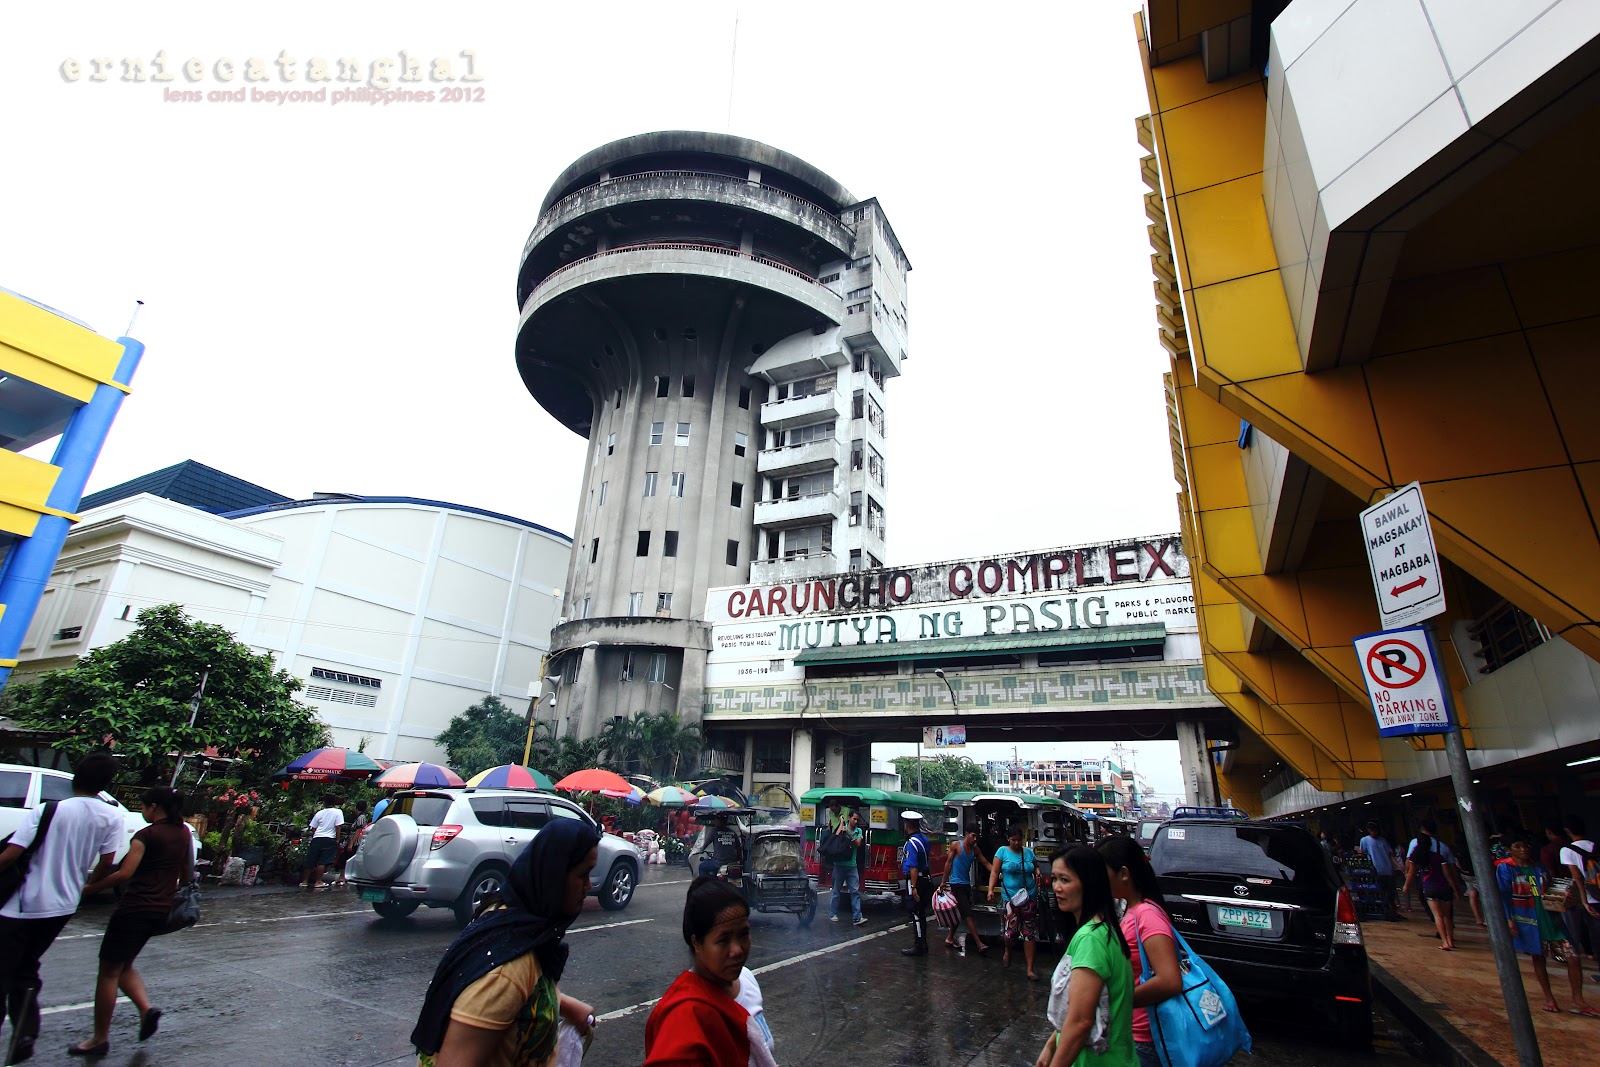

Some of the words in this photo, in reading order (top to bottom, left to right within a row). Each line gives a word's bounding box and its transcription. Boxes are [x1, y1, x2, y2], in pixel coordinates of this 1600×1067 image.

[1374, 502, 1410, 529] BAWAL
[1370, 514, 1424, 550] MAGSAKAY
[1393, 543, 1407, 558] AT
[1380, 553, 1432, 582] MAGBABA
[727, 571, 914, 619] CARUNCHO
[948, 542, 1177, 597] COMPLEX
[1114, 599, 1142, 608] PARKS
[1126, 609, 1159, 619] PUBLIC
[778, 615, 898, 651] MUTYA
[918, 610, 964, 639] NG
[983, 595, 1110, 636] PASIG
[745, 631, 777, 639] RESTAURANT
[1374, 690, 1391, 704] NO
[1378, 698, 1437, 717] PARKING
[1382, 717, 1395, 726] TOW
[1397, 713, 1415, 724] AWAY
[1419, 712, 1440, 722] ZONE
[1222, 908, 1242, 921] ZPP
